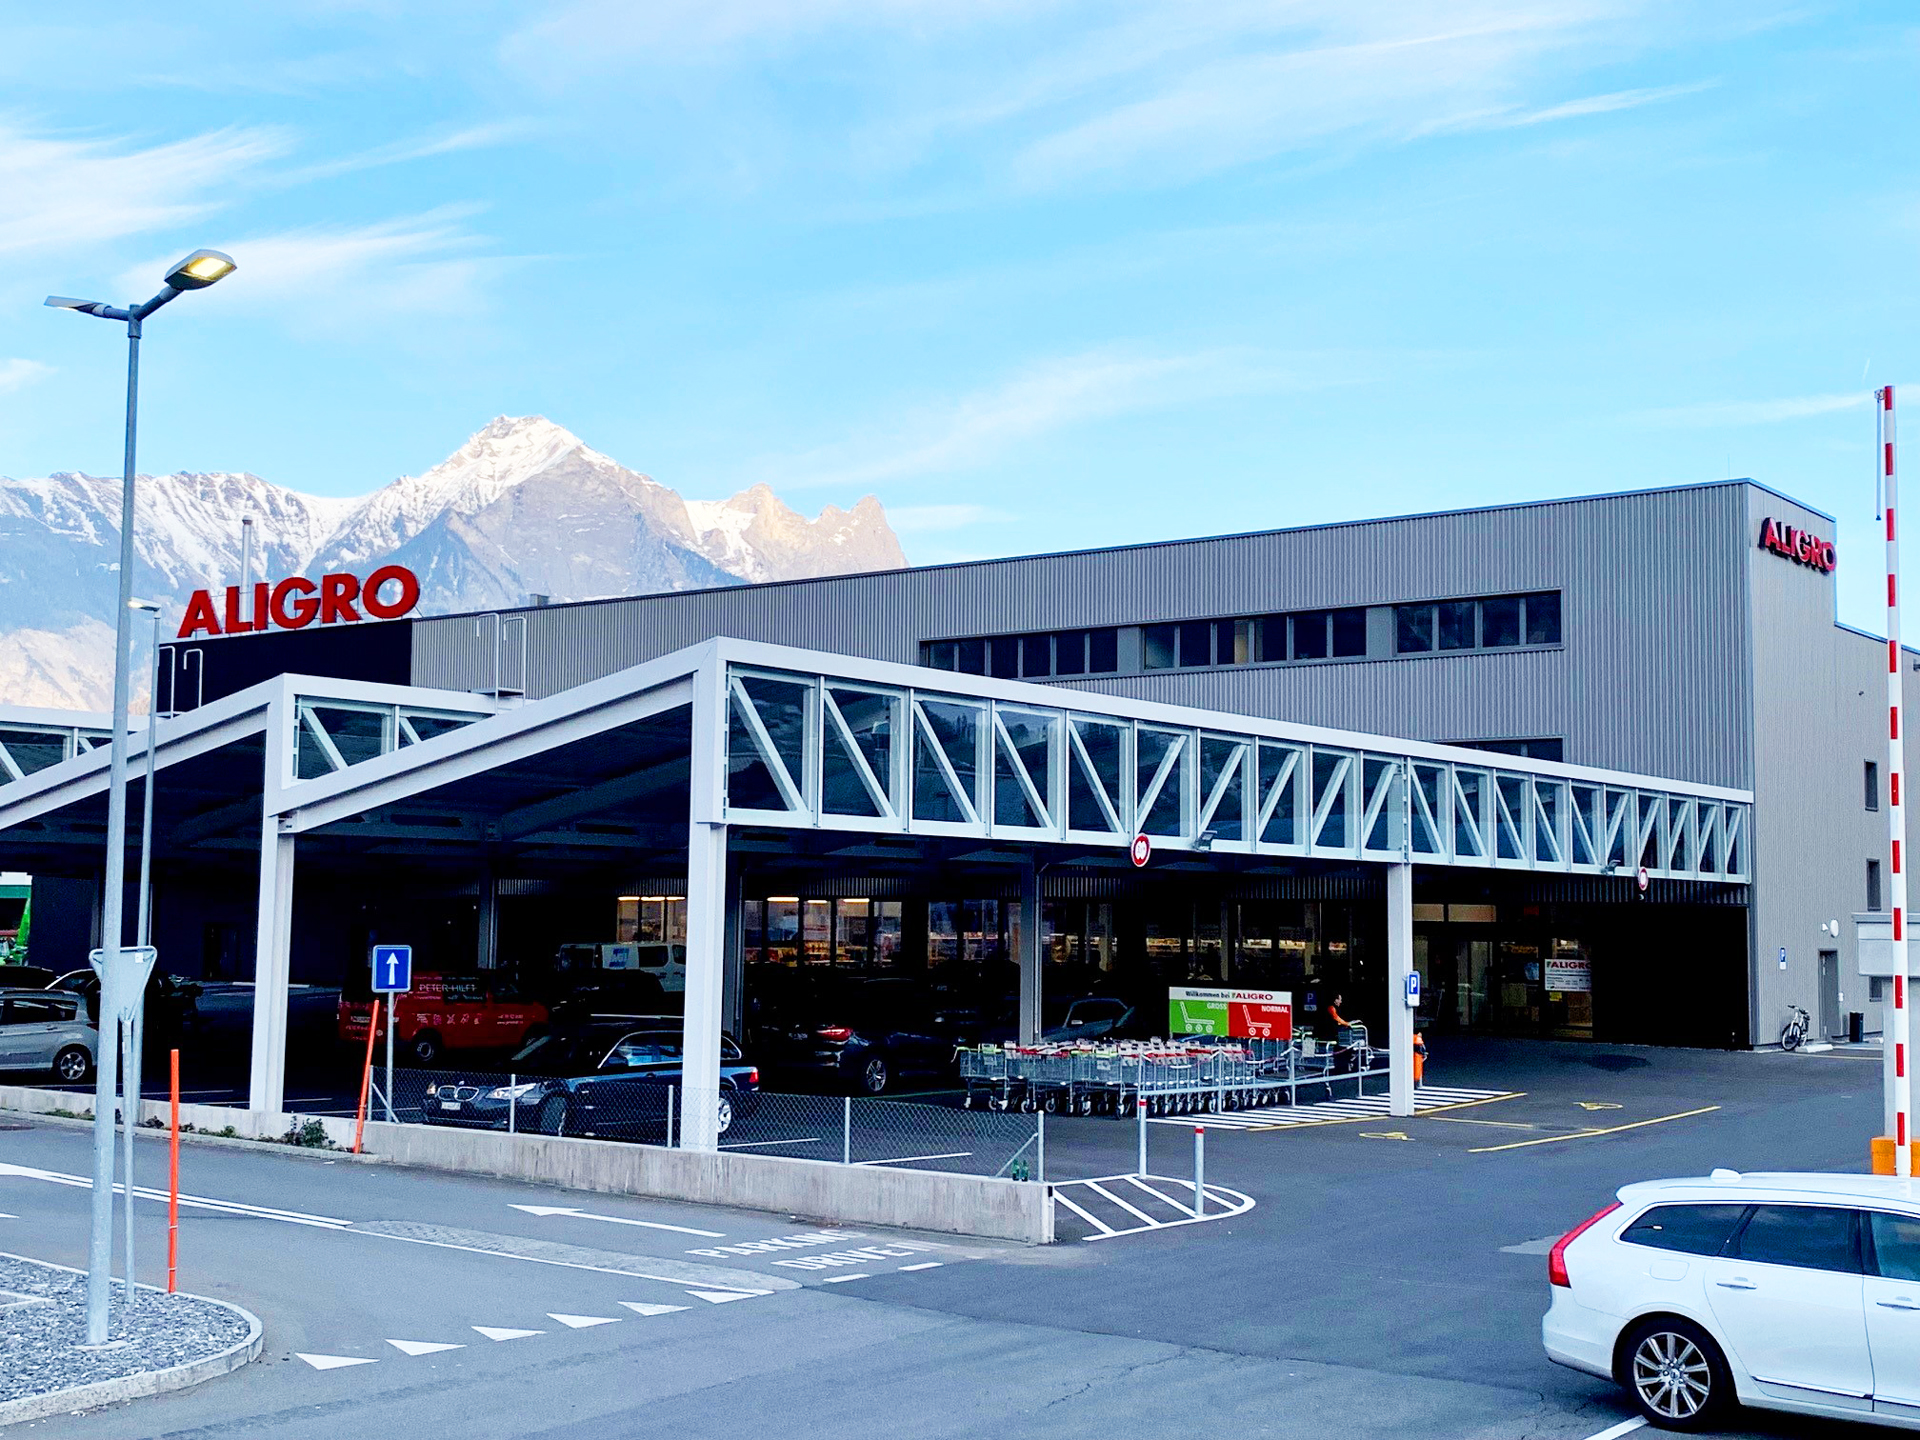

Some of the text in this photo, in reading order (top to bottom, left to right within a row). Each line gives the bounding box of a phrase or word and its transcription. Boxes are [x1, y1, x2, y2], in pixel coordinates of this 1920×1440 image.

[1760, 517, 1837, 572] ALIGRO
[176, 564, 421, 639] ALIGRO
[1410, 976, 1417, 993] P
[1185, 990, 1220, 998] Willkommen
[1235, 992, 1274, 1001] ALIGRO
[1206, 1002, 1227, 1010] GROSS
[1261, 1005, 1289, 1014] NORMAL
[685, 1230, 866, 1258] PARKING
[771, 1246, 914, 1270] DRIVE
